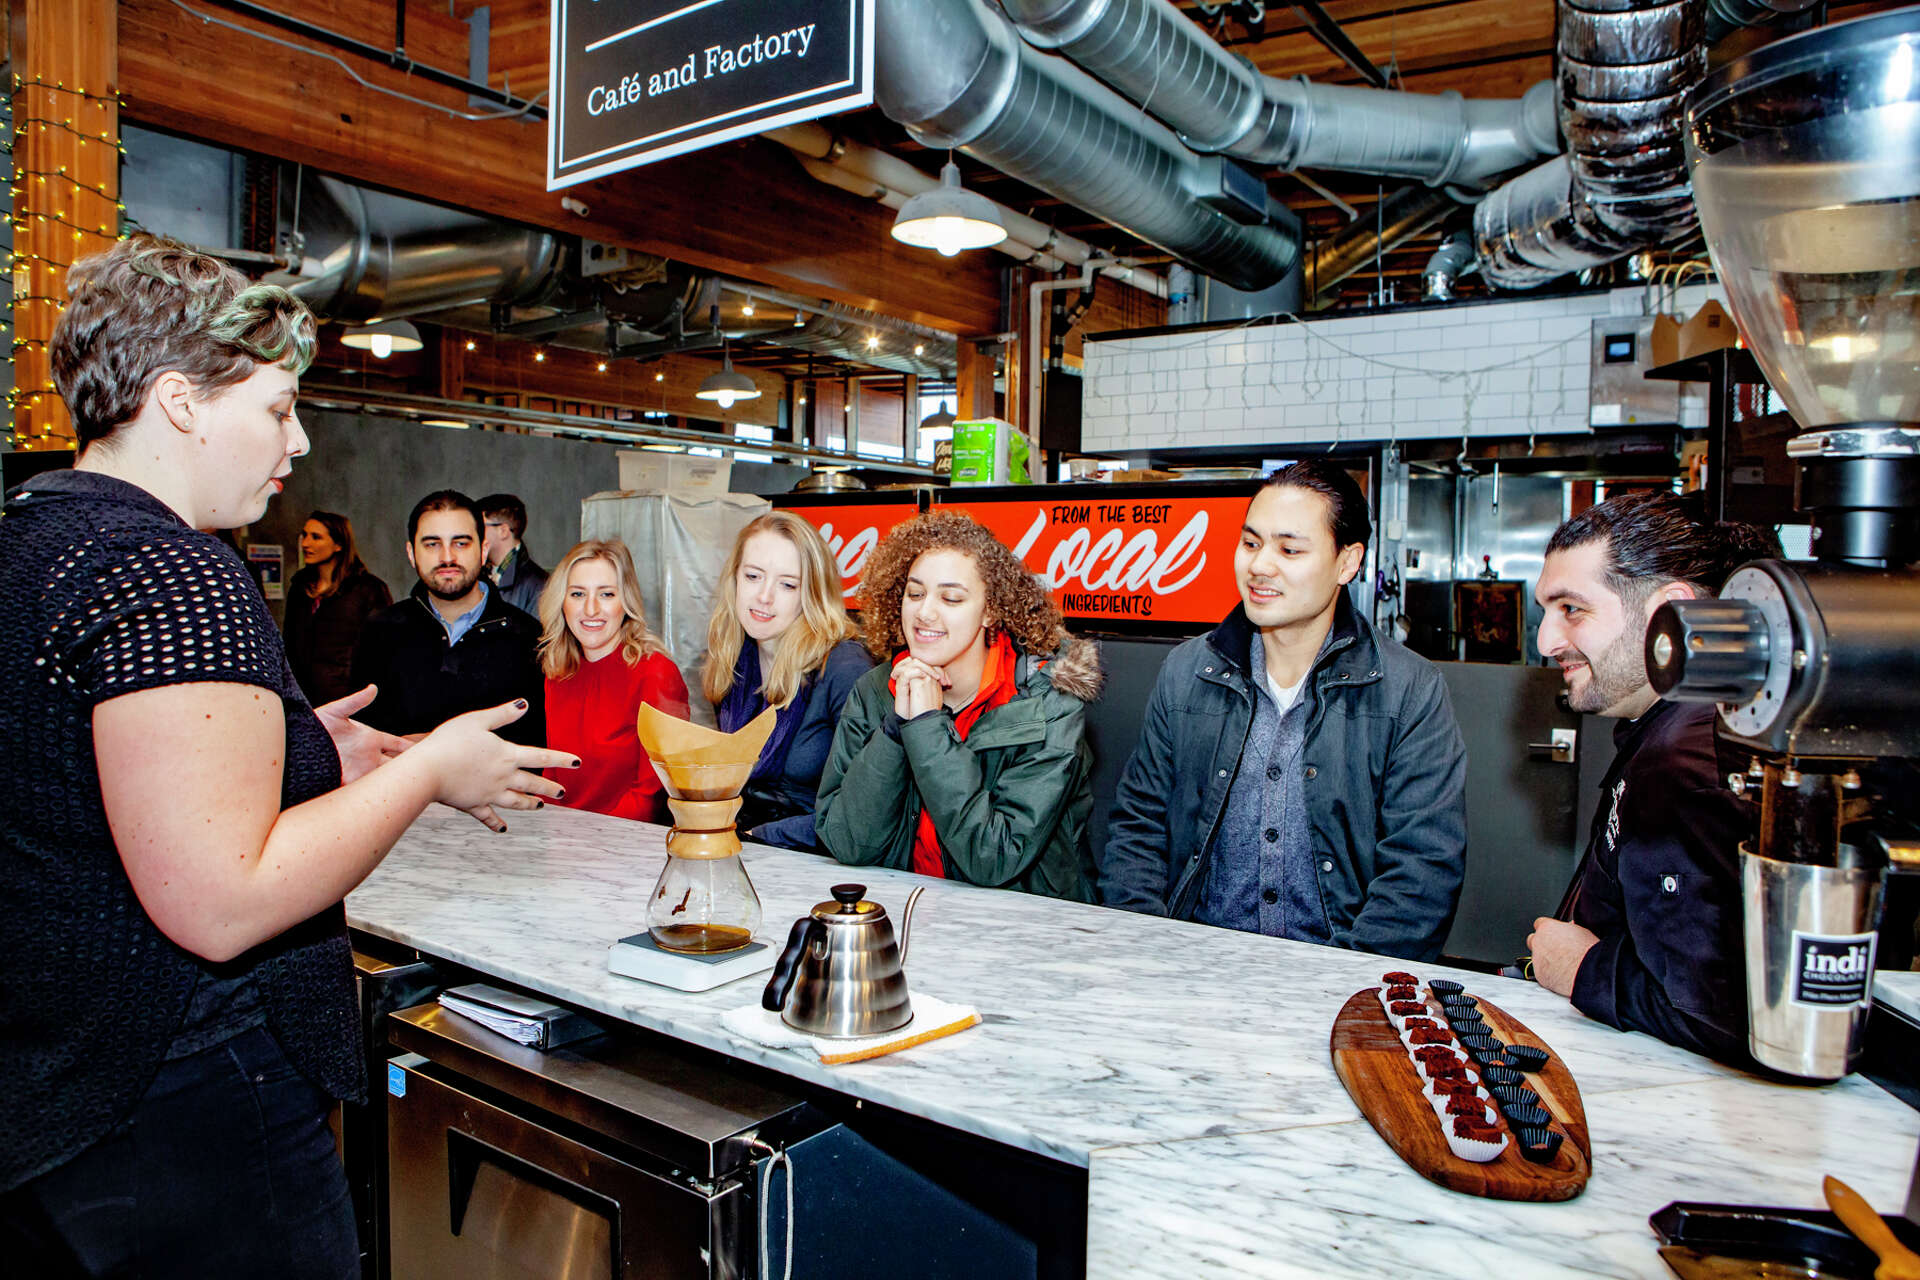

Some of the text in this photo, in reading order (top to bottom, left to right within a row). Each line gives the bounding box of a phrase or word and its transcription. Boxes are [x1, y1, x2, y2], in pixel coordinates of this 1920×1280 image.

[587, 23, 816, 117] Café and Factory
[1052, 505, 1173, 526] FROM THE BEST
[1062, 593, 1153, 617] INGREDIENTS
[1805, 945, 1868, 974] indi
